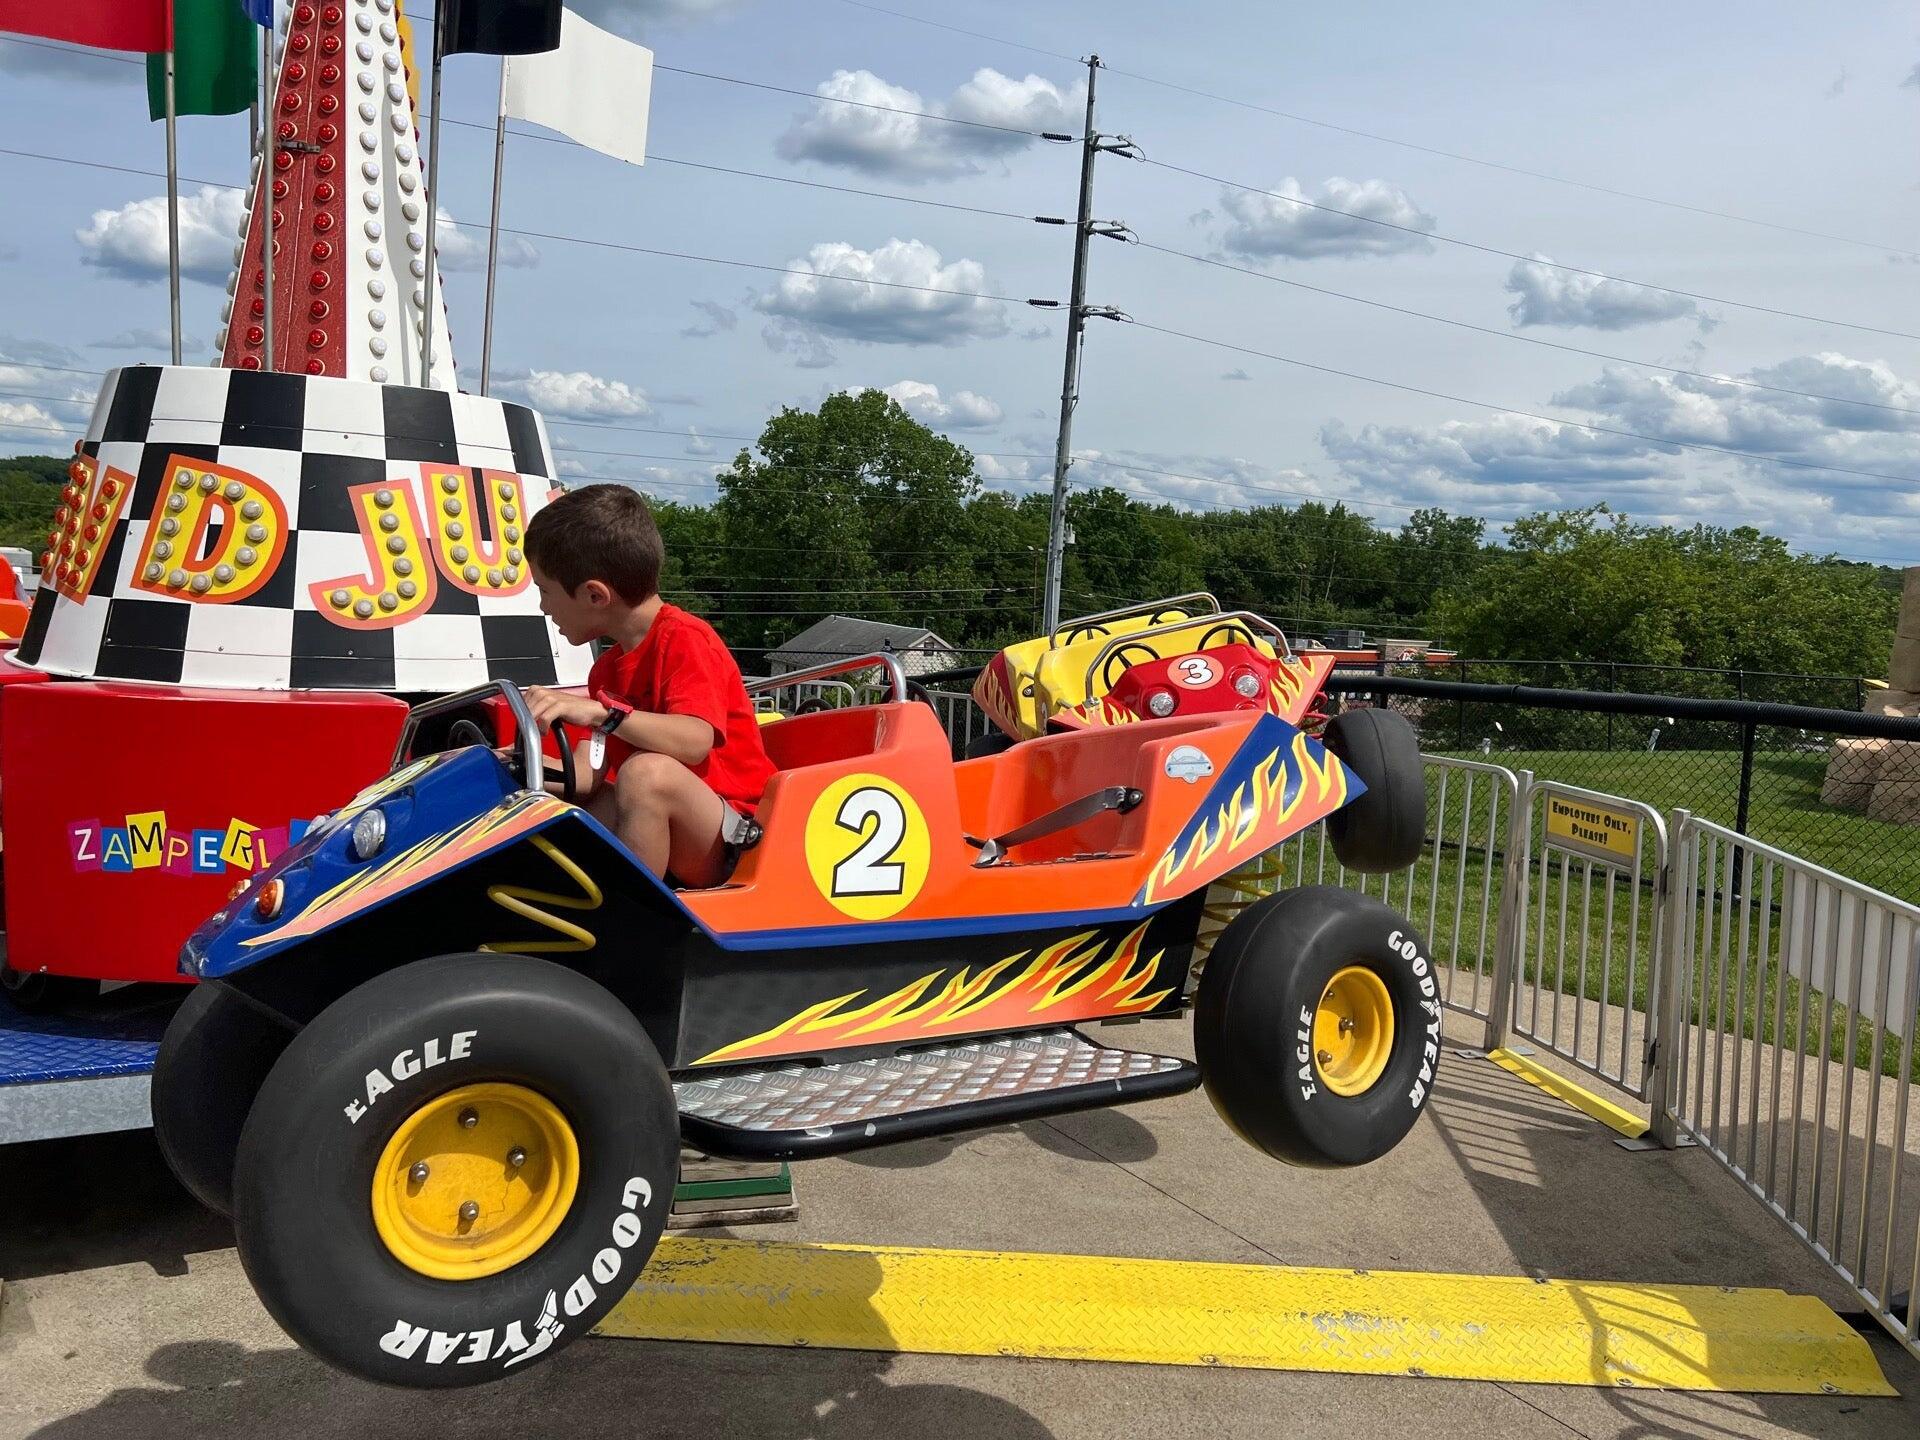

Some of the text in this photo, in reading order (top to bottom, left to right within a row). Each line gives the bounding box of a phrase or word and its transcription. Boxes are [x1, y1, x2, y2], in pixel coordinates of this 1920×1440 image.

[308, 463, 564, 631] JU
[1178, 657, 1214, 686] 3
[831, 786, 907, 898] 2
[1552, 800, 1601, 825] EMPLOYEES
[1571, 822, 1609, 845] PLEASE!
[1296, 1004, 1317, 1101] EAGLE
[1387, 930, 1442, 1109] GOODYEAR
[343, 1030, 478, 1125] EAGLE
[379, 1176, 652, 1366] GOODYEAR
